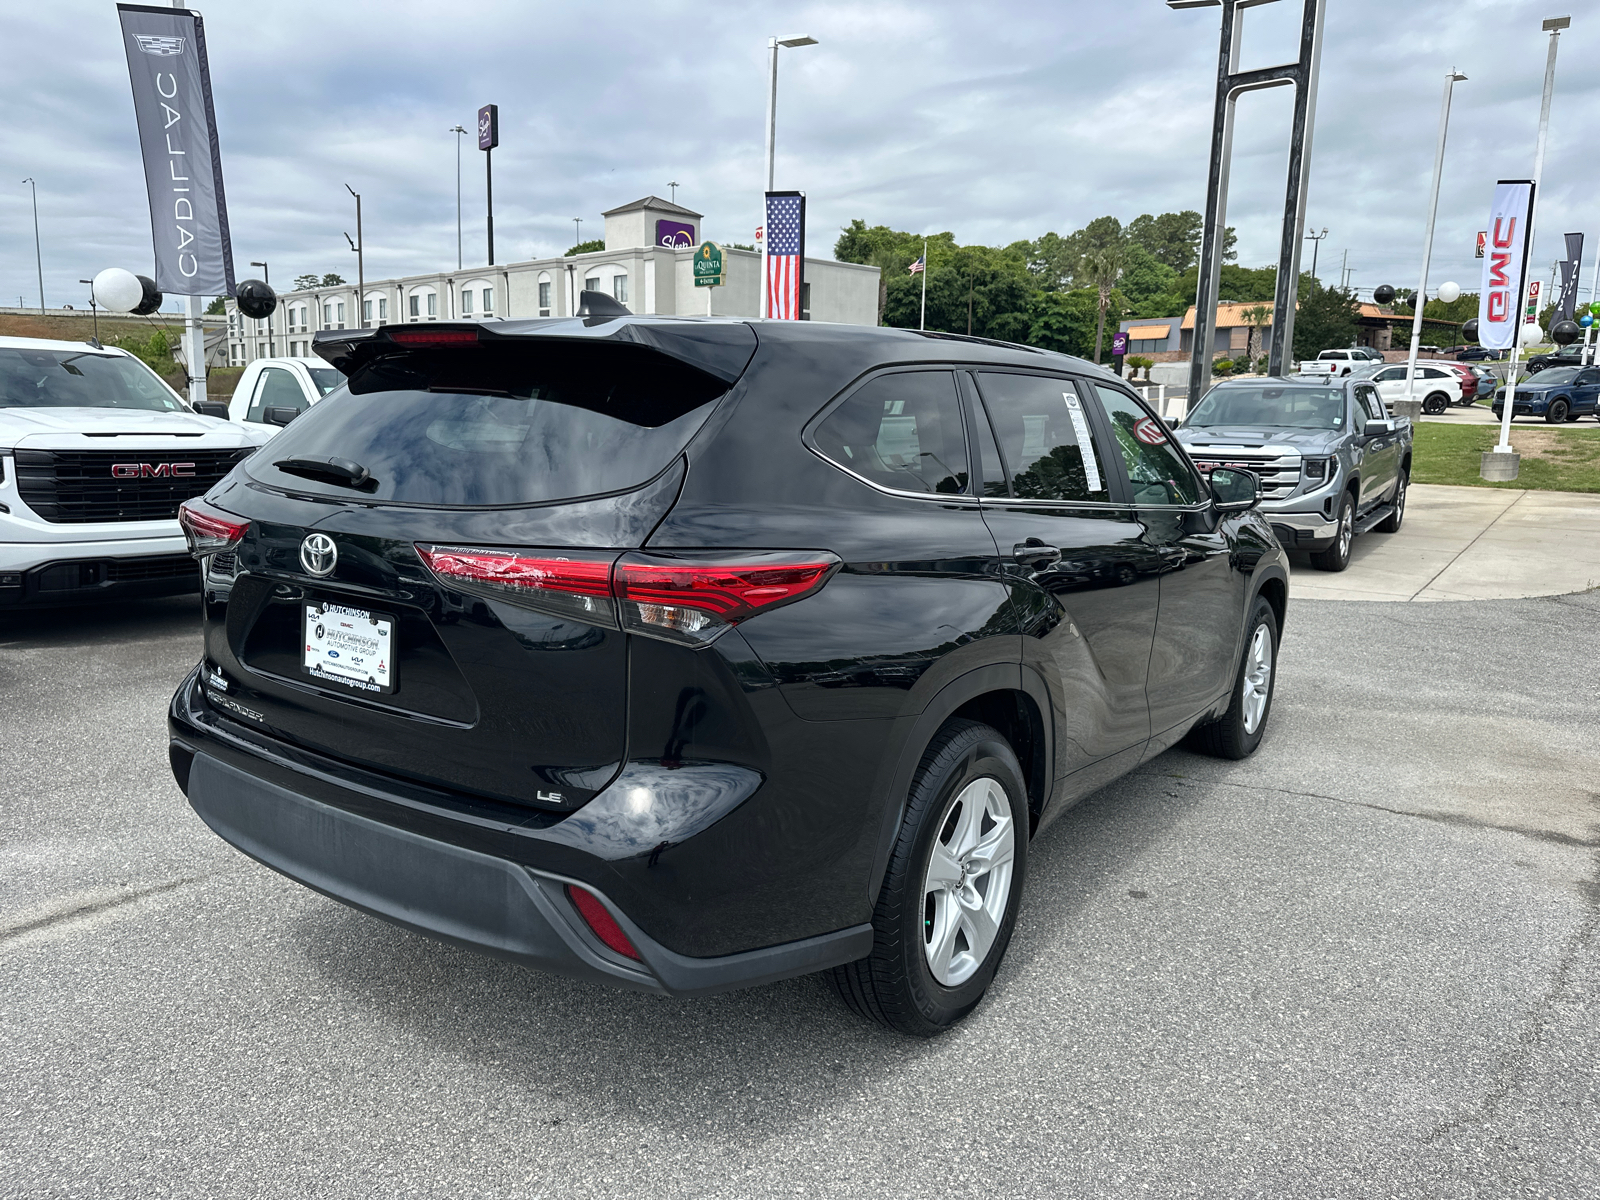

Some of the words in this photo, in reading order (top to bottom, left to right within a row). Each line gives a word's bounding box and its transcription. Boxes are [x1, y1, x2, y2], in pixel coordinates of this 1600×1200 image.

[698, 260, 720, 271] QUINTA
[112, 462, 196, 479] GMC
[329, 604, 371, 619] HUTCHINSON
[326, 640, 359, 653] AUTOMOTIVE
[359, 646, 377, 656] GROUP
[309, 667, 381, 692] Hutchinsonautogroup.com
[536, 790, 562, 803] LE
